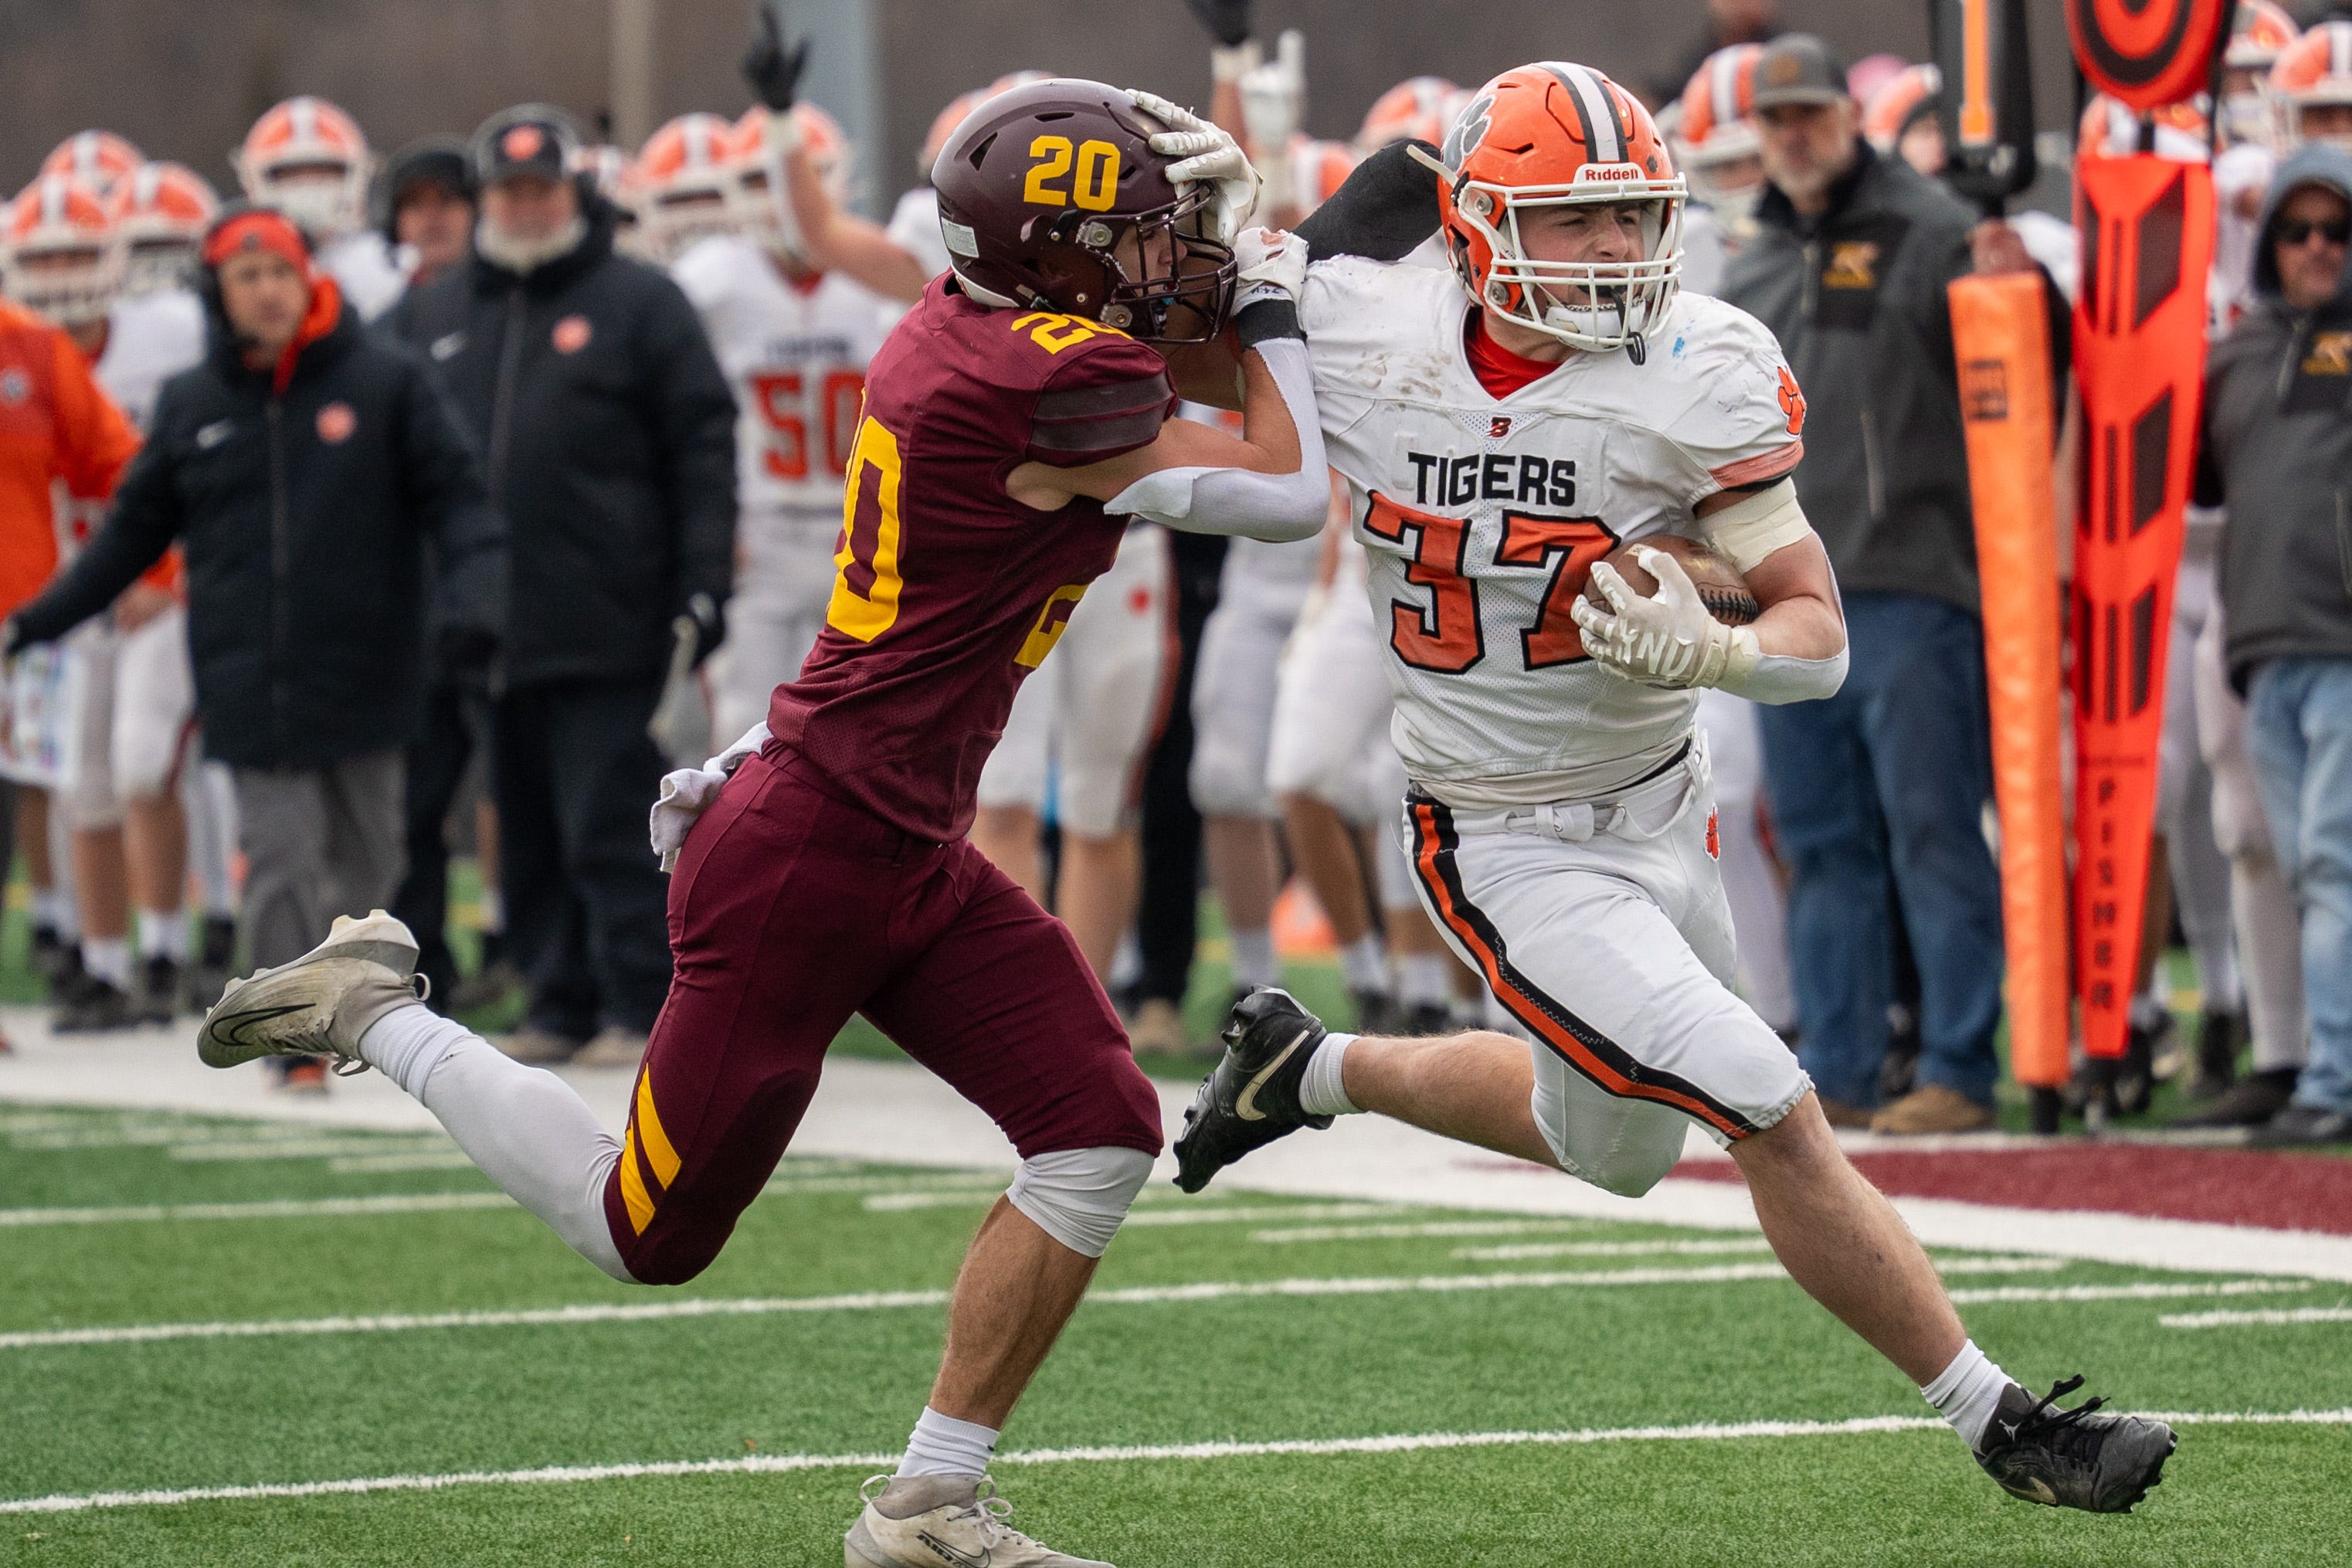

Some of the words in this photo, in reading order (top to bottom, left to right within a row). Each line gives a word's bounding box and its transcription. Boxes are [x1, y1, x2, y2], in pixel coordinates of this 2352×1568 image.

[1023, 135, 1121, 212] 20
[1585, 168, 1638, 181] Riddell
[751, 372, 865, 480] 50
[827, 386, 904, 643] 0
[1408, 451, 1576, 507] TIGERS
[1363, 490, 1621, 674] 37
